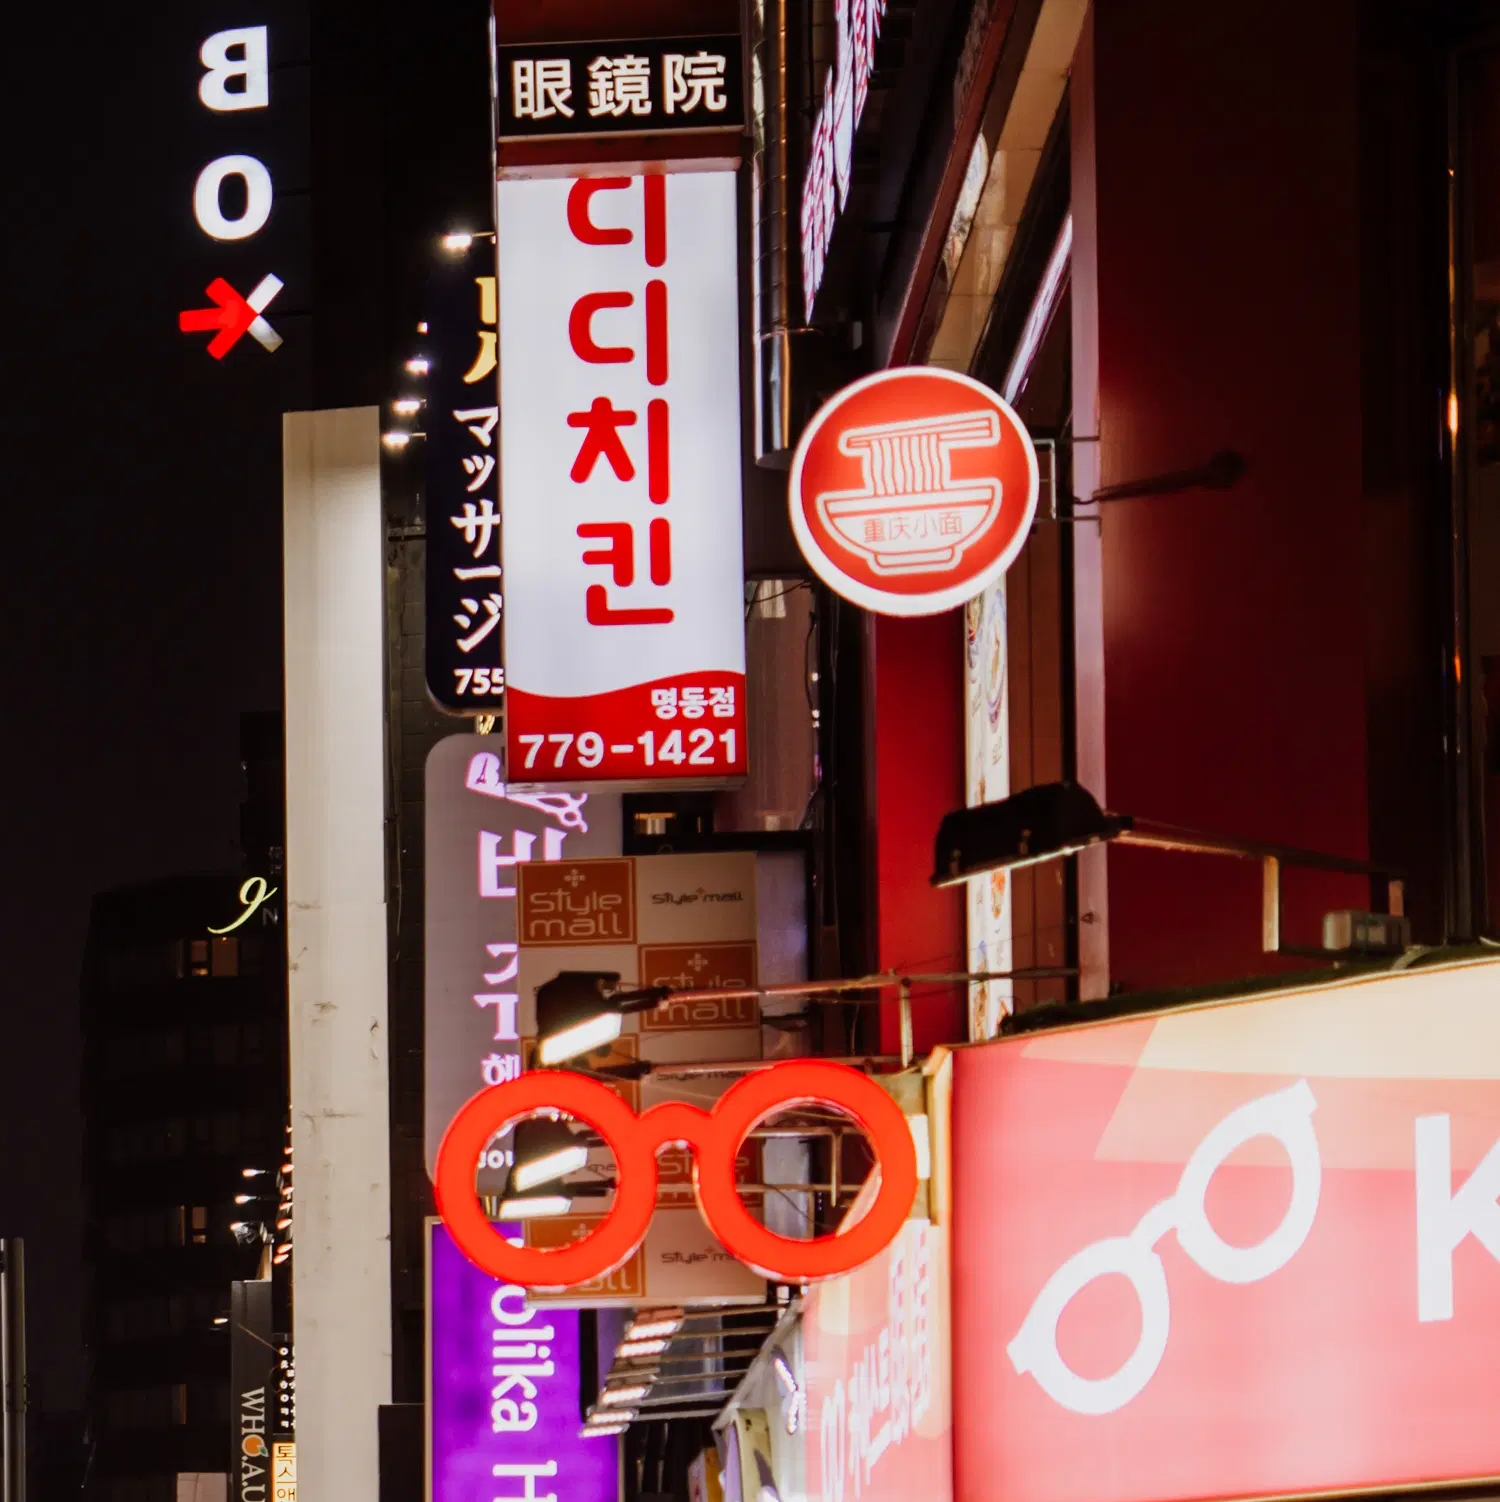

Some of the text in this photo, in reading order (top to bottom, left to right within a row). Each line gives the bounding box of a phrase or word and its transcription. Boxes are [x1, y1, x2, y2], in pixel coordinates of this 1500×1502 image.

[512, 51, 728, 121] 眼鏡院
[454, 668, 504, 696] 755
[650, 685, 736, 719] 명동점
[518, 730, 737, 770] 779-1421
[490, 1285, 556, 1435] olika
